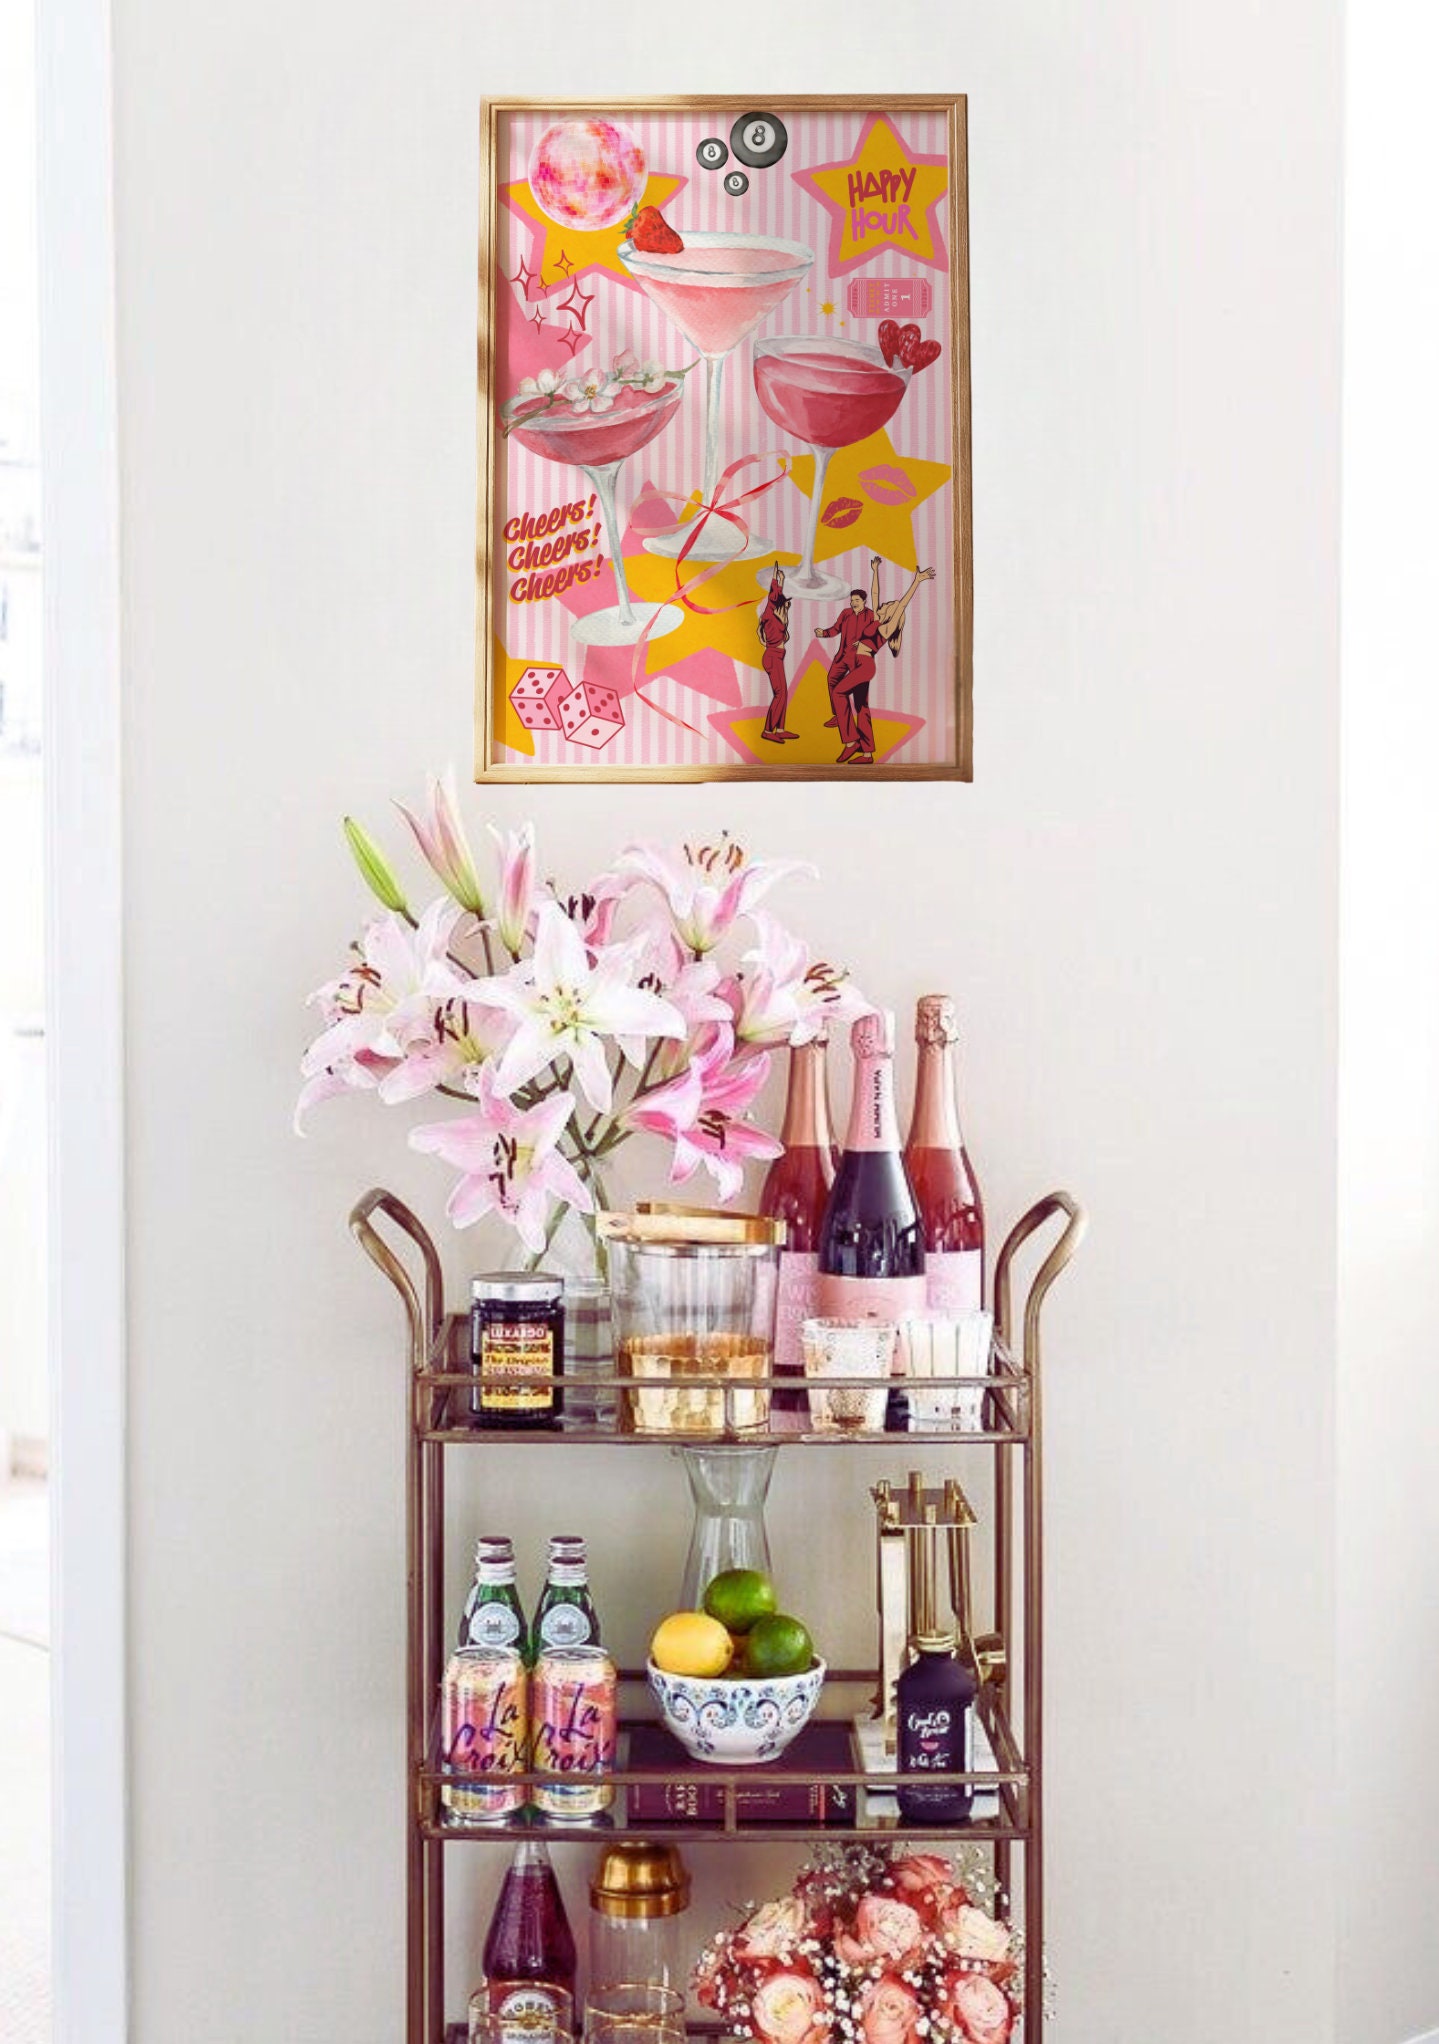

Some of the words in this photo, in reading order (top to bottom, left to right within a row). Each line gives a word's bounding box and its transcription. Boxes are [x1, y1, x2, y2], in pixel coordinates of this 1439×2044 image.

[752, 125, 765, 146] 8
[708, 145, 716, 157] 8
[732, 177, 739, 186] 8
[851, 204, 919, 241] HOUR
